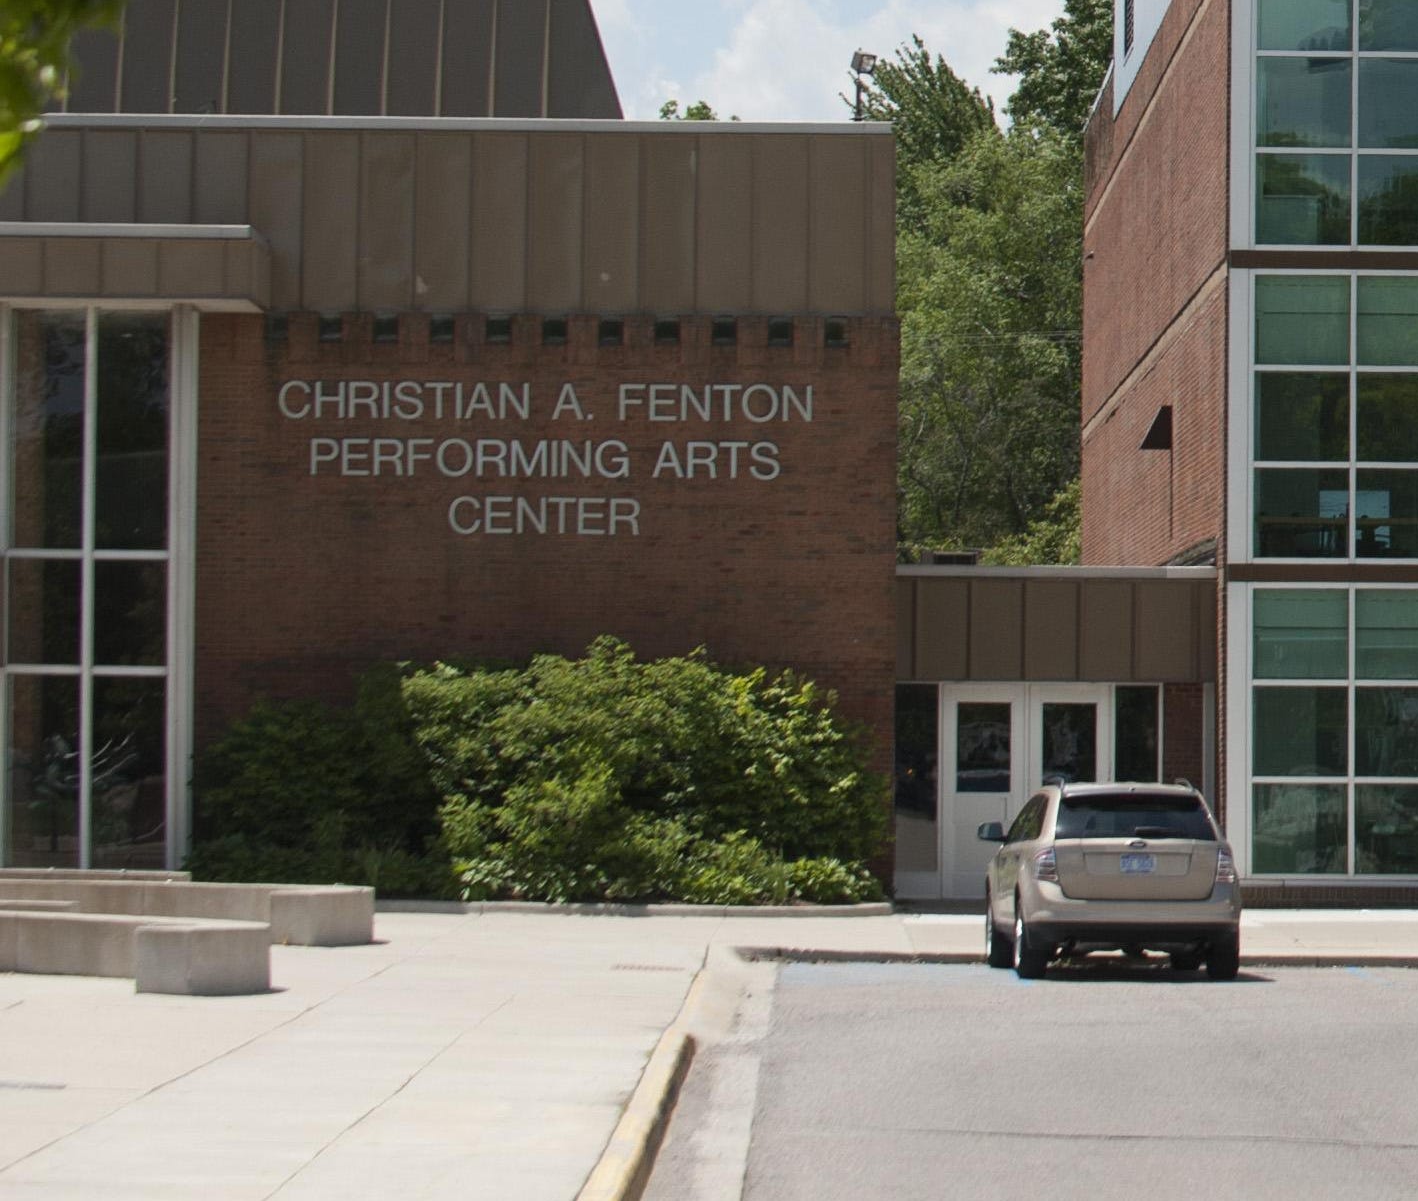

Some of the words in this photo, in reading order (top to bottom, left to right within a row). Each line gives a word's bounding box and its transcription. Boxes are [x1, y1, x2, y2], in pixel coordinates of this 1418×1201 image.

[277, 380, 531, 420] CHRISTIAN
[551, 383, 595, 420] A.
[618, 383, 814, 423] FENTON
[309, 437, 630, 479] PERFORMING
[652, 441, 781, 481] ARTS
[448, 496, 641, 535] CENTER
